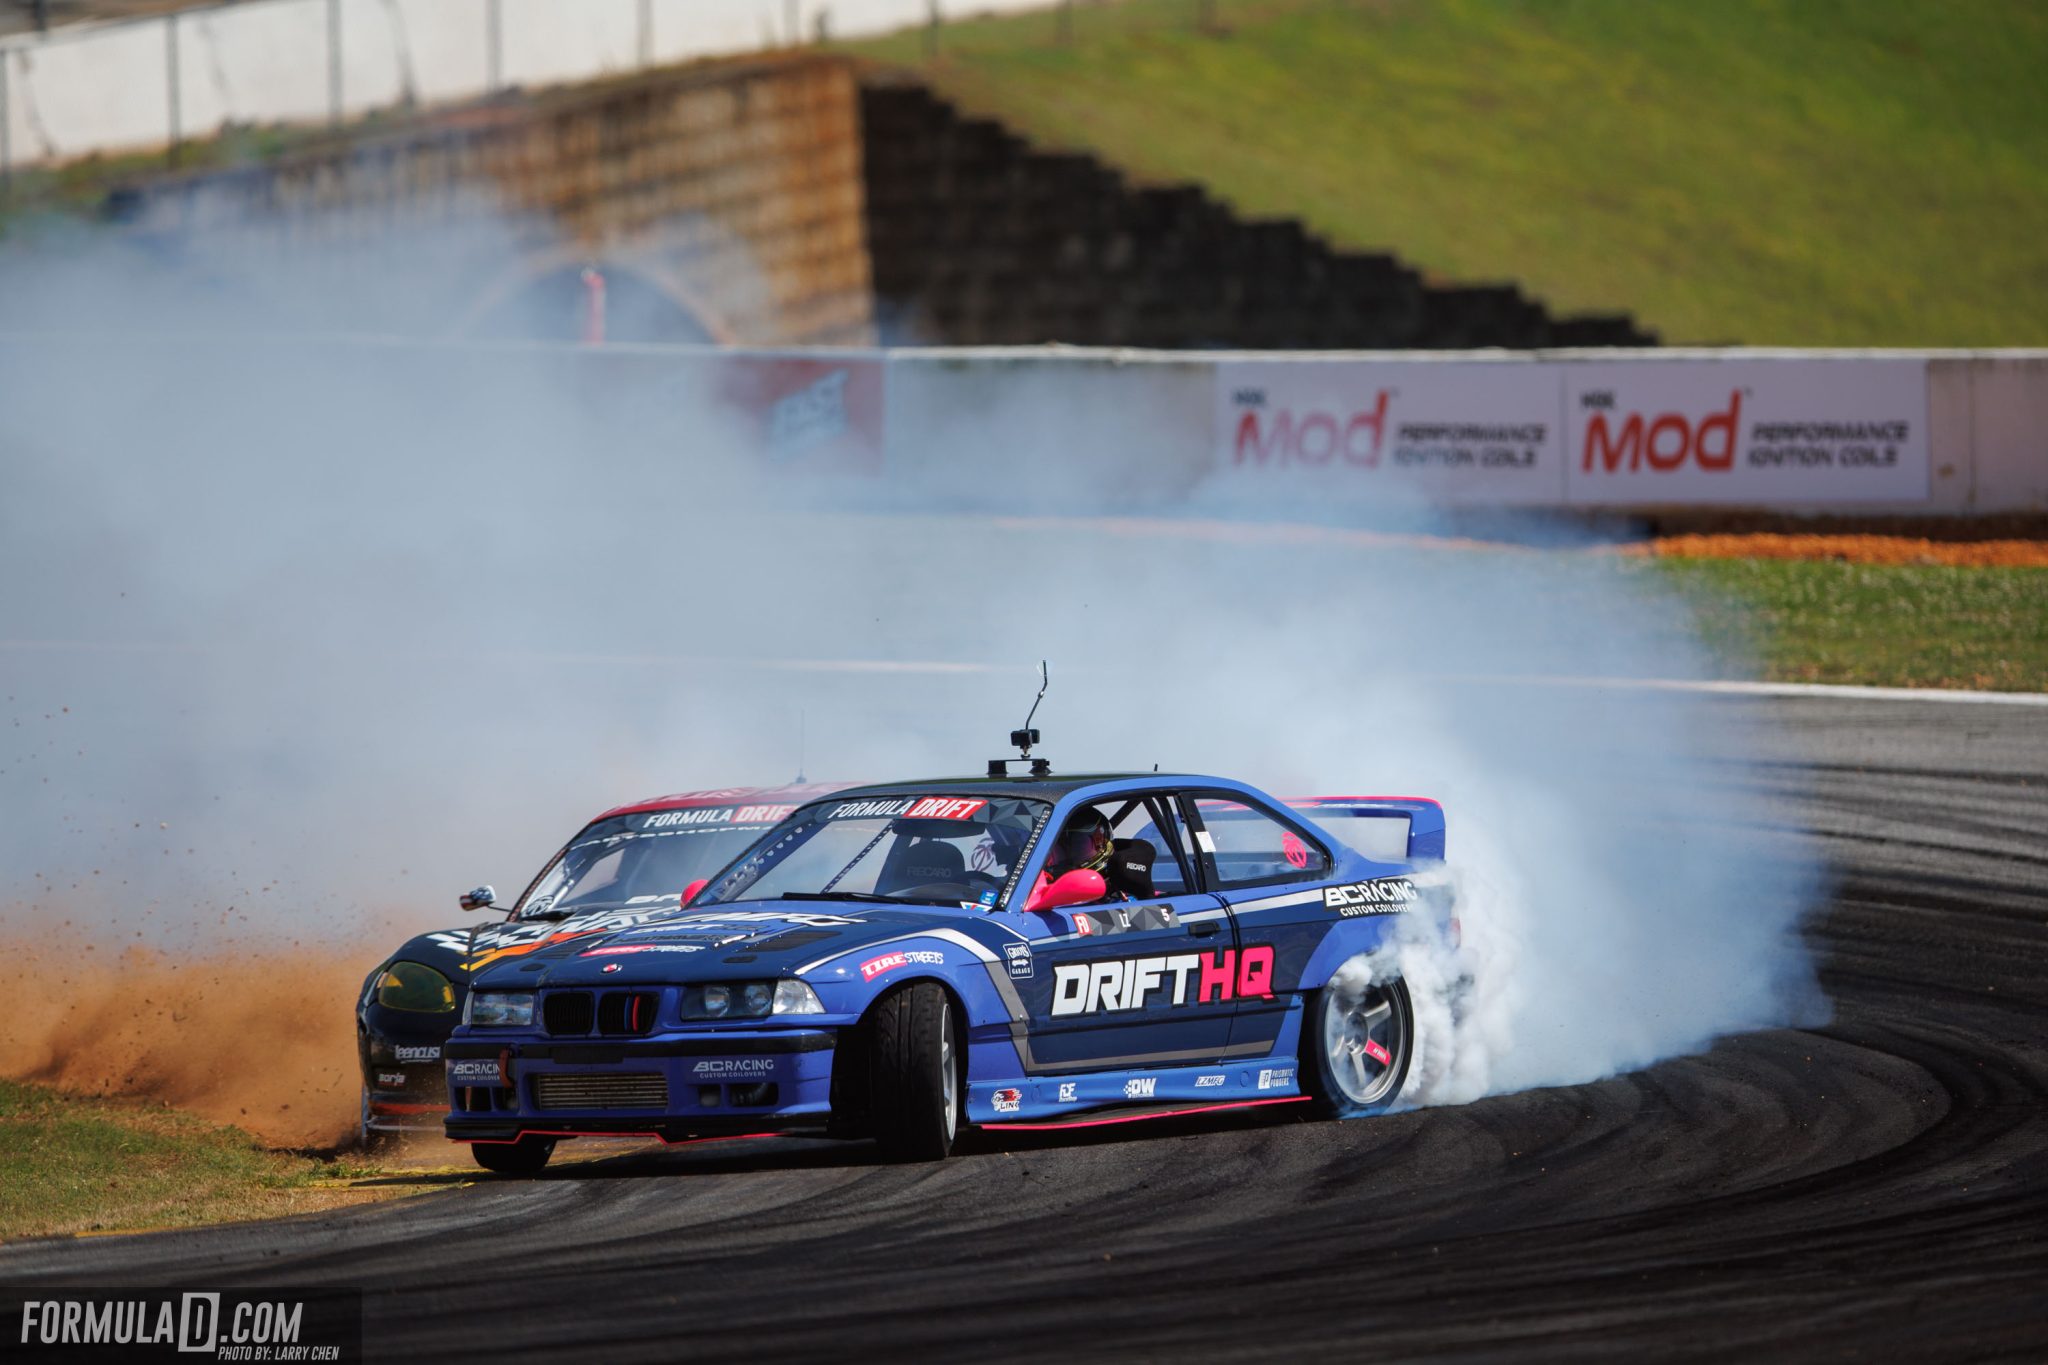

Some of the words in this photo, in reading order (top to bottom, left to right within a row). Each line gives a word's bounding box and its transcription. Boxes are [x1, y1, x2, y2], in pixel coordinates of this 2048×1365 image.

[1235, 389, 1389, 469] Mod
[1581, 389, 1743, 474] Mod
[1752, 422, 1908, 443] PERFORMANCE
[827, 800, 916, 819] FORMULA
[908, 799, 982, 818] DRIFT
[643, 808, 734, 828] FORMULA
[907, 866, 951, 878] RECARO
[1126, 862, 1147, 872] RECARO
[1160, 908, 1170, 922] 5
[1340, 905, 1375, 917] CUSTOM
[1012, 967, 1031, 975] GARAGE
